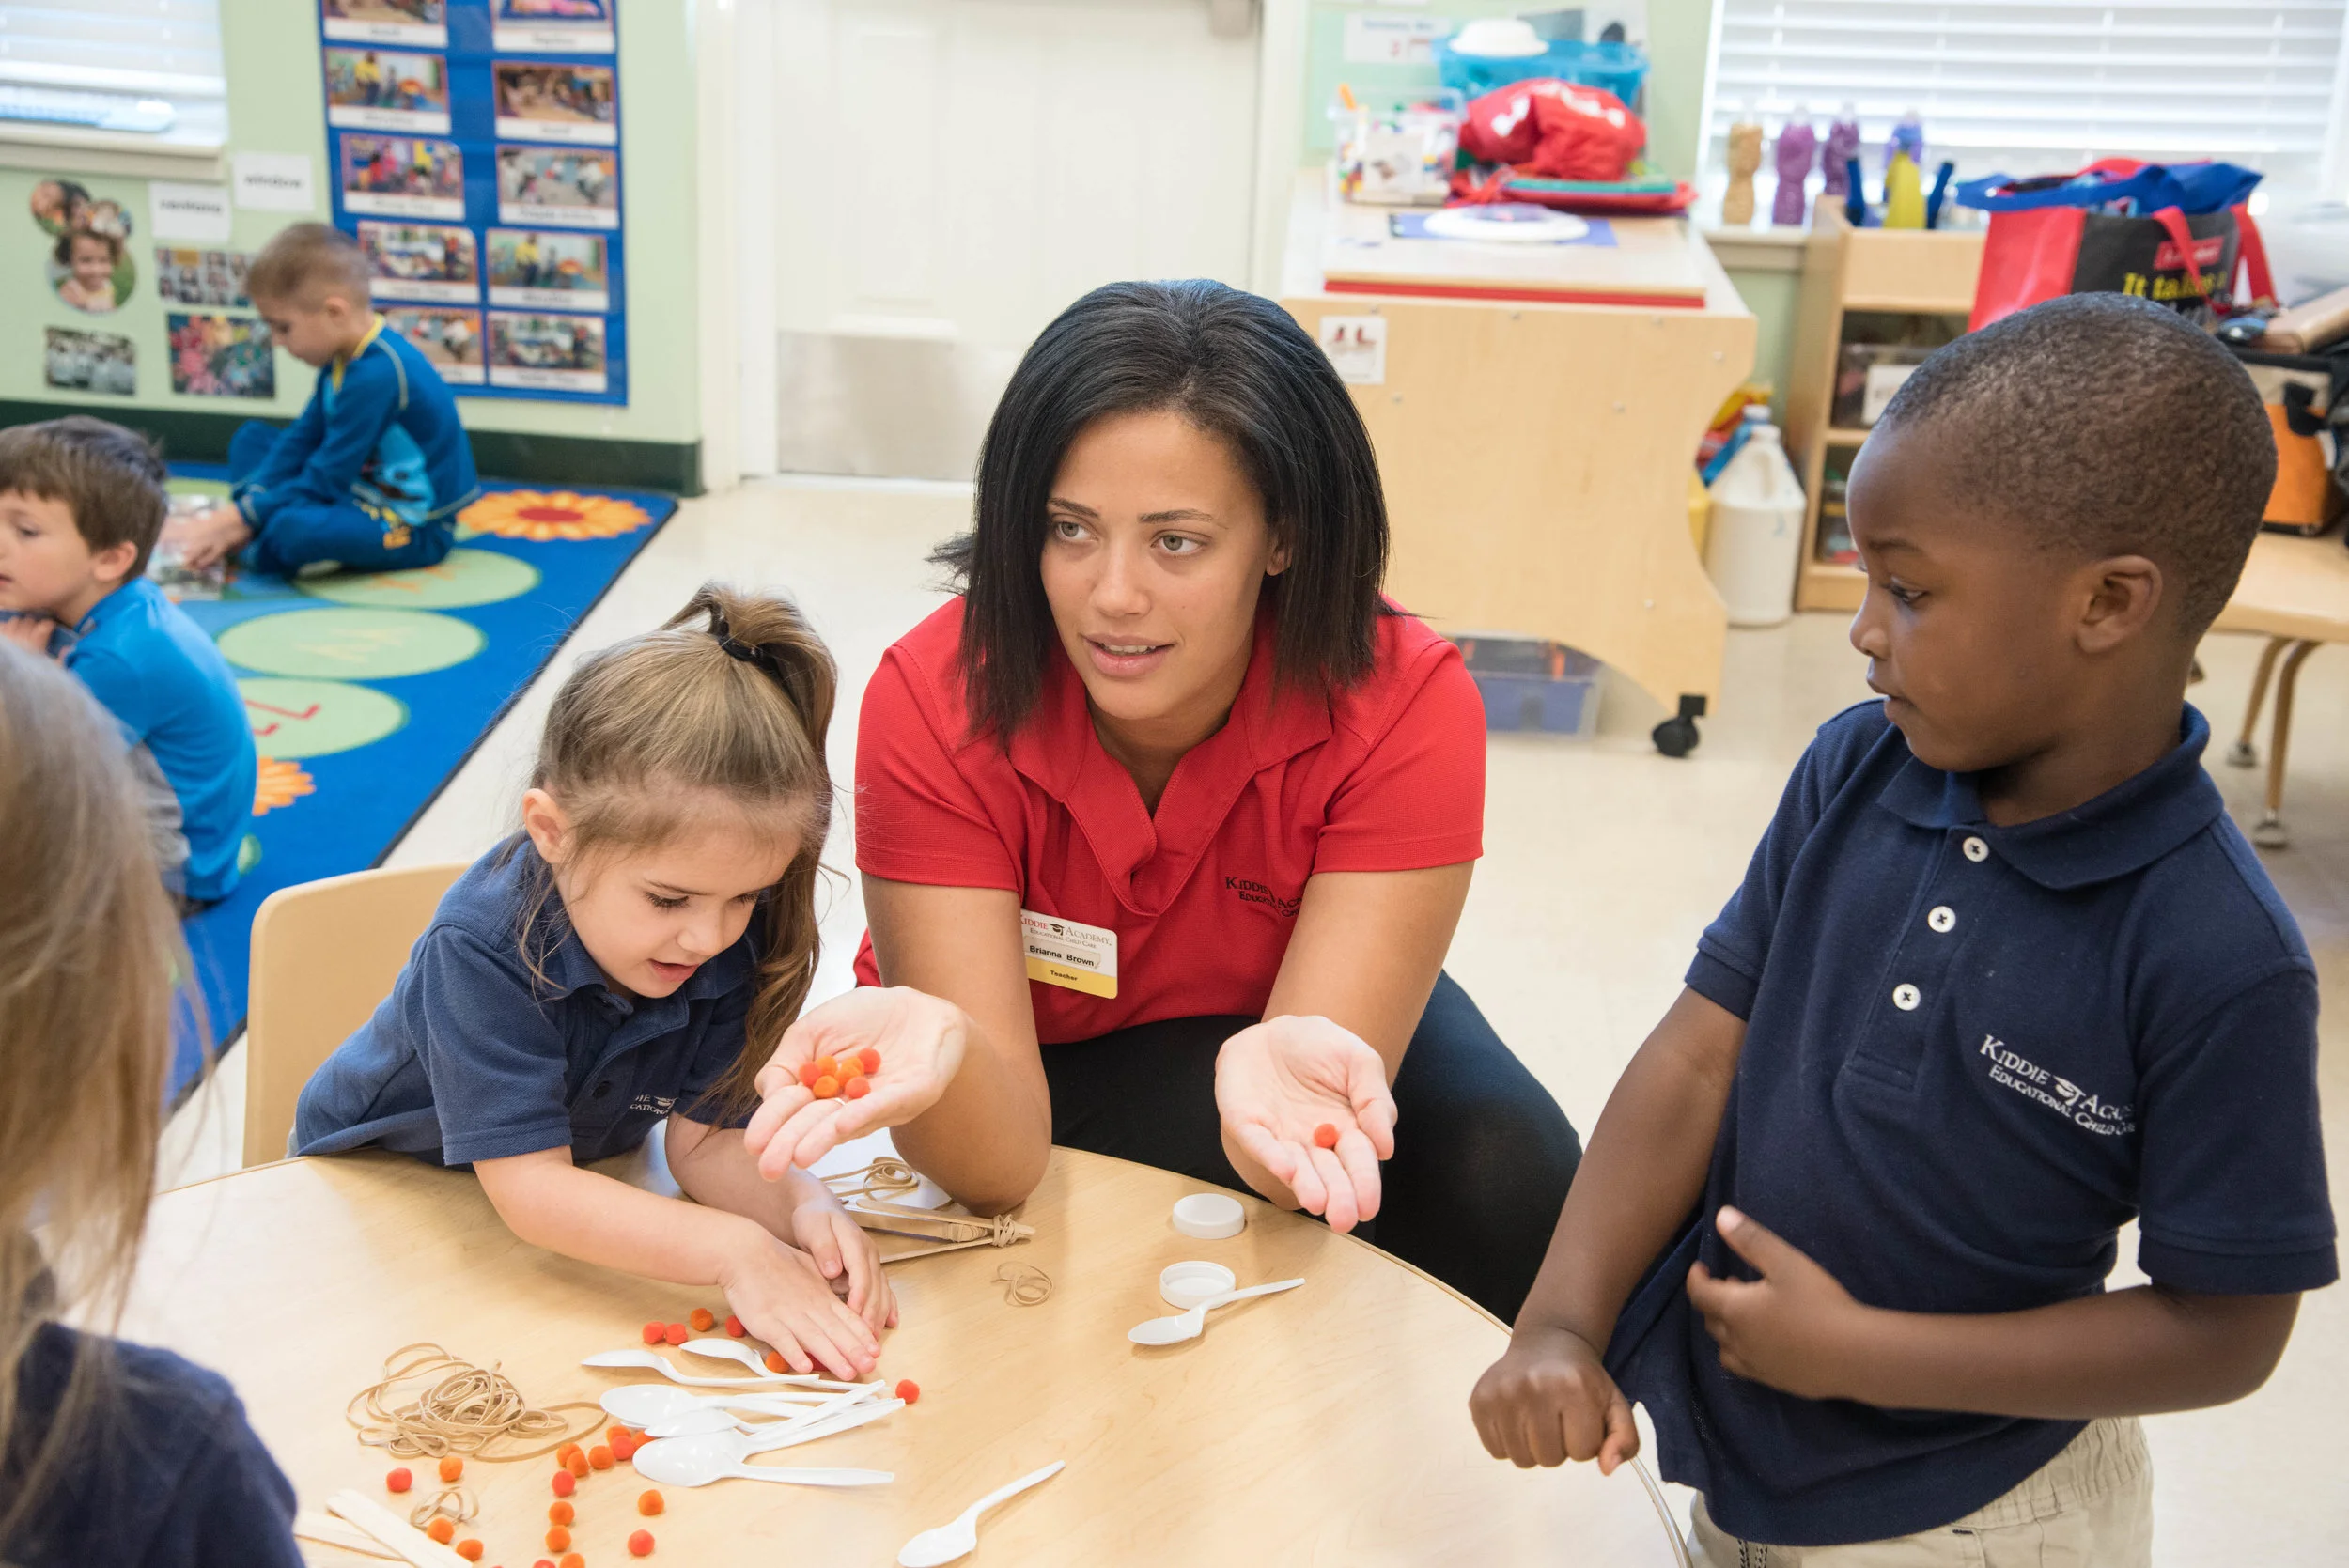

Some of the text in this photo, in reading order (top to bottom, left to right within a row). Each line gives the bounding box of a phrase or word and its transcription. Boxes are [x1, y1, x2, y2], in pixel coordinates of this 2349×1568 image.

[1029, 945, 1094, 967] Brianna Brown
[1050, 970, 1078, 981] Teacher
[1979, 1033, 2051, 1085] KIDDIE
[1988, 1063, 2072, 1118] EDUCATIONAL
